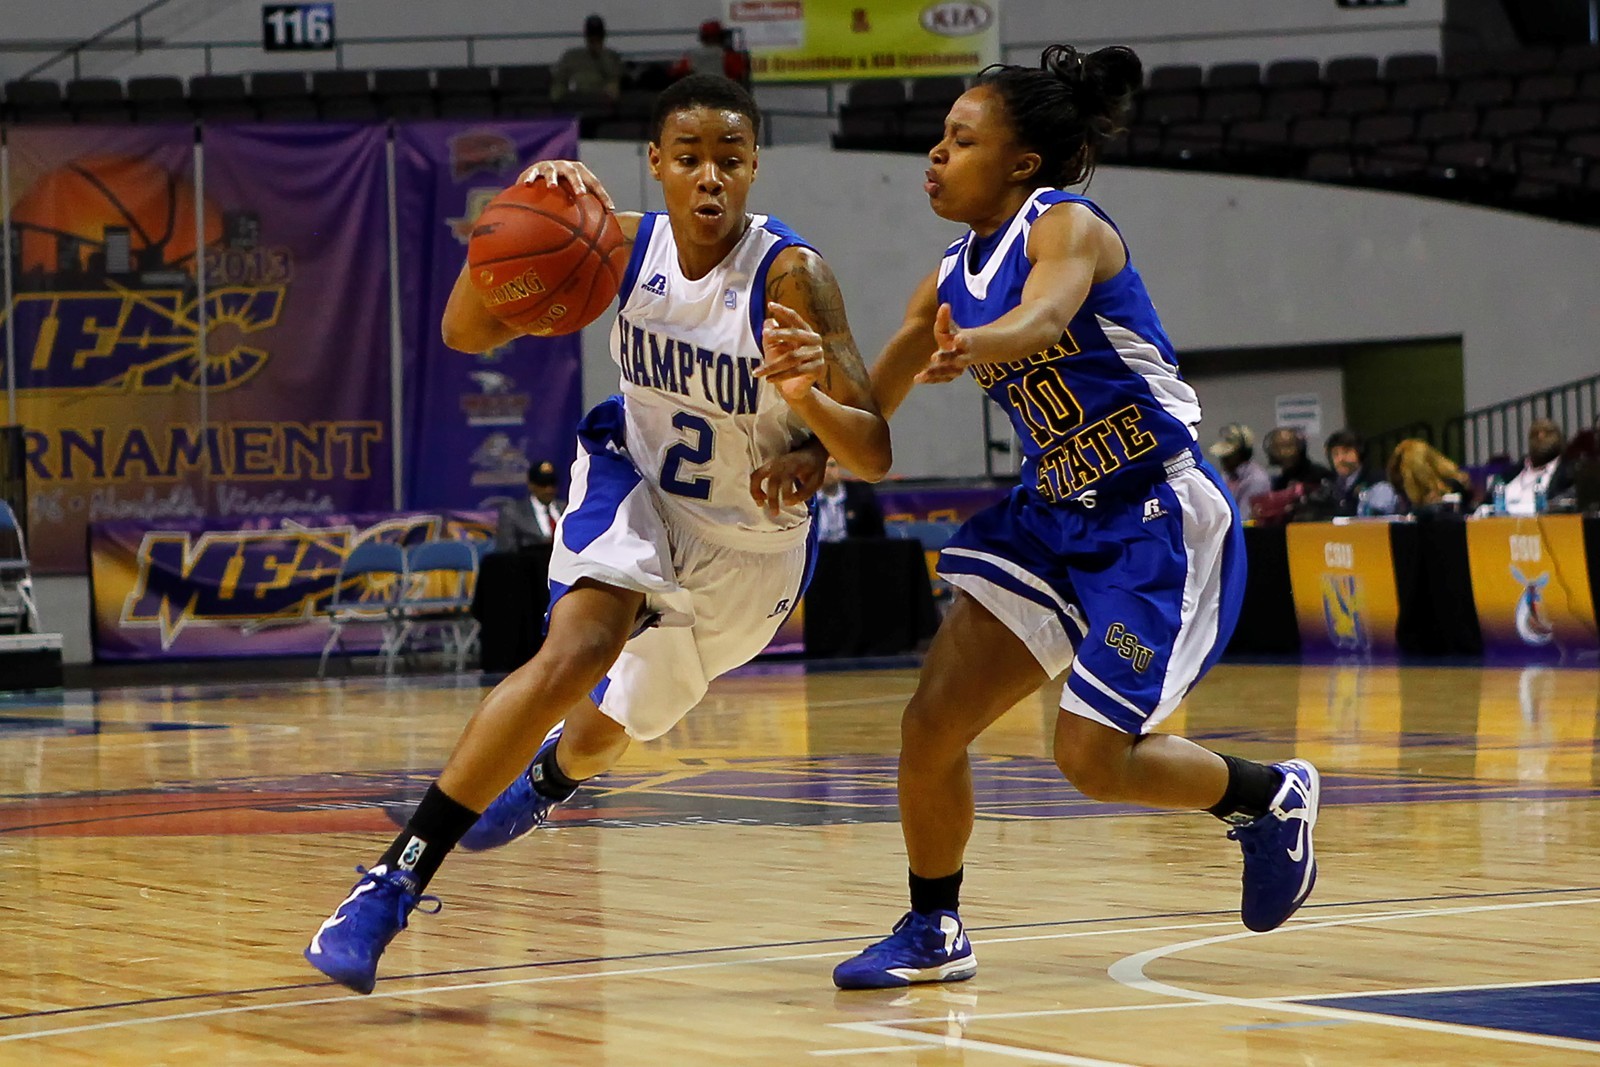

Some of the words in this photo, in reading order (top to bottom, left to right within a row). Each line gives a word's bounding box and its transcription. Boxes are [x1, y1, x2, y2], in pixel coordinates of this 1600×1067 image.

[267, 8, 330, 44] 116
[931, 7, 982, 28] KIA
[617, 314, 763, 415] HAMPTON
[1007, 365, 1084, 449] 10
[659, 411, 717, 501] 2
[1036, 404, 1158, 503] STATE
[1105, 622, 1154, 673] CSU
